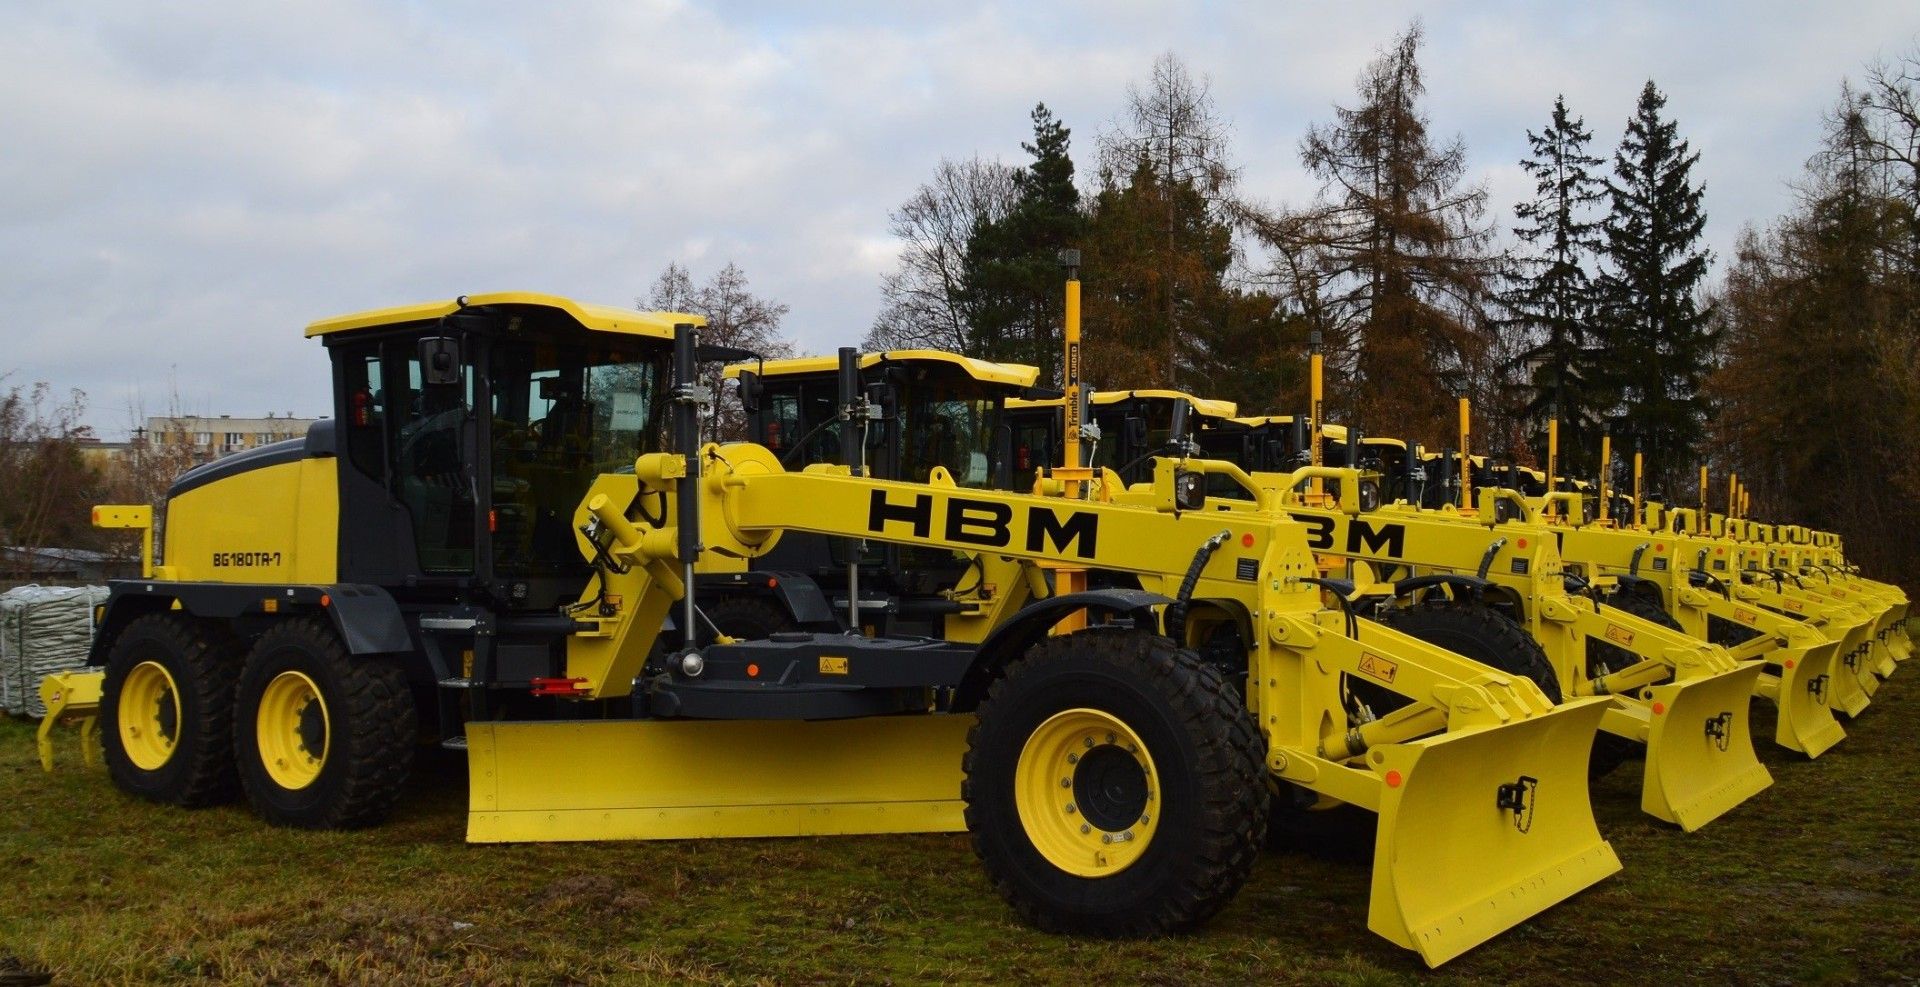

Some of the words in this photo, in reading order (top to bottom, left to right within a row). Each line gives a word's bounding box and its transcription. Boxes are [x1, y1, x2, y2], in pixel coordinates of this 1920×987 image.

[1068, 391, 1078, 427] Trimble
[868, 488, 1099, 559] HBM
[1287, 512, 1405, 558] BM
[213, 552, 281, 567] BG180TA-7
